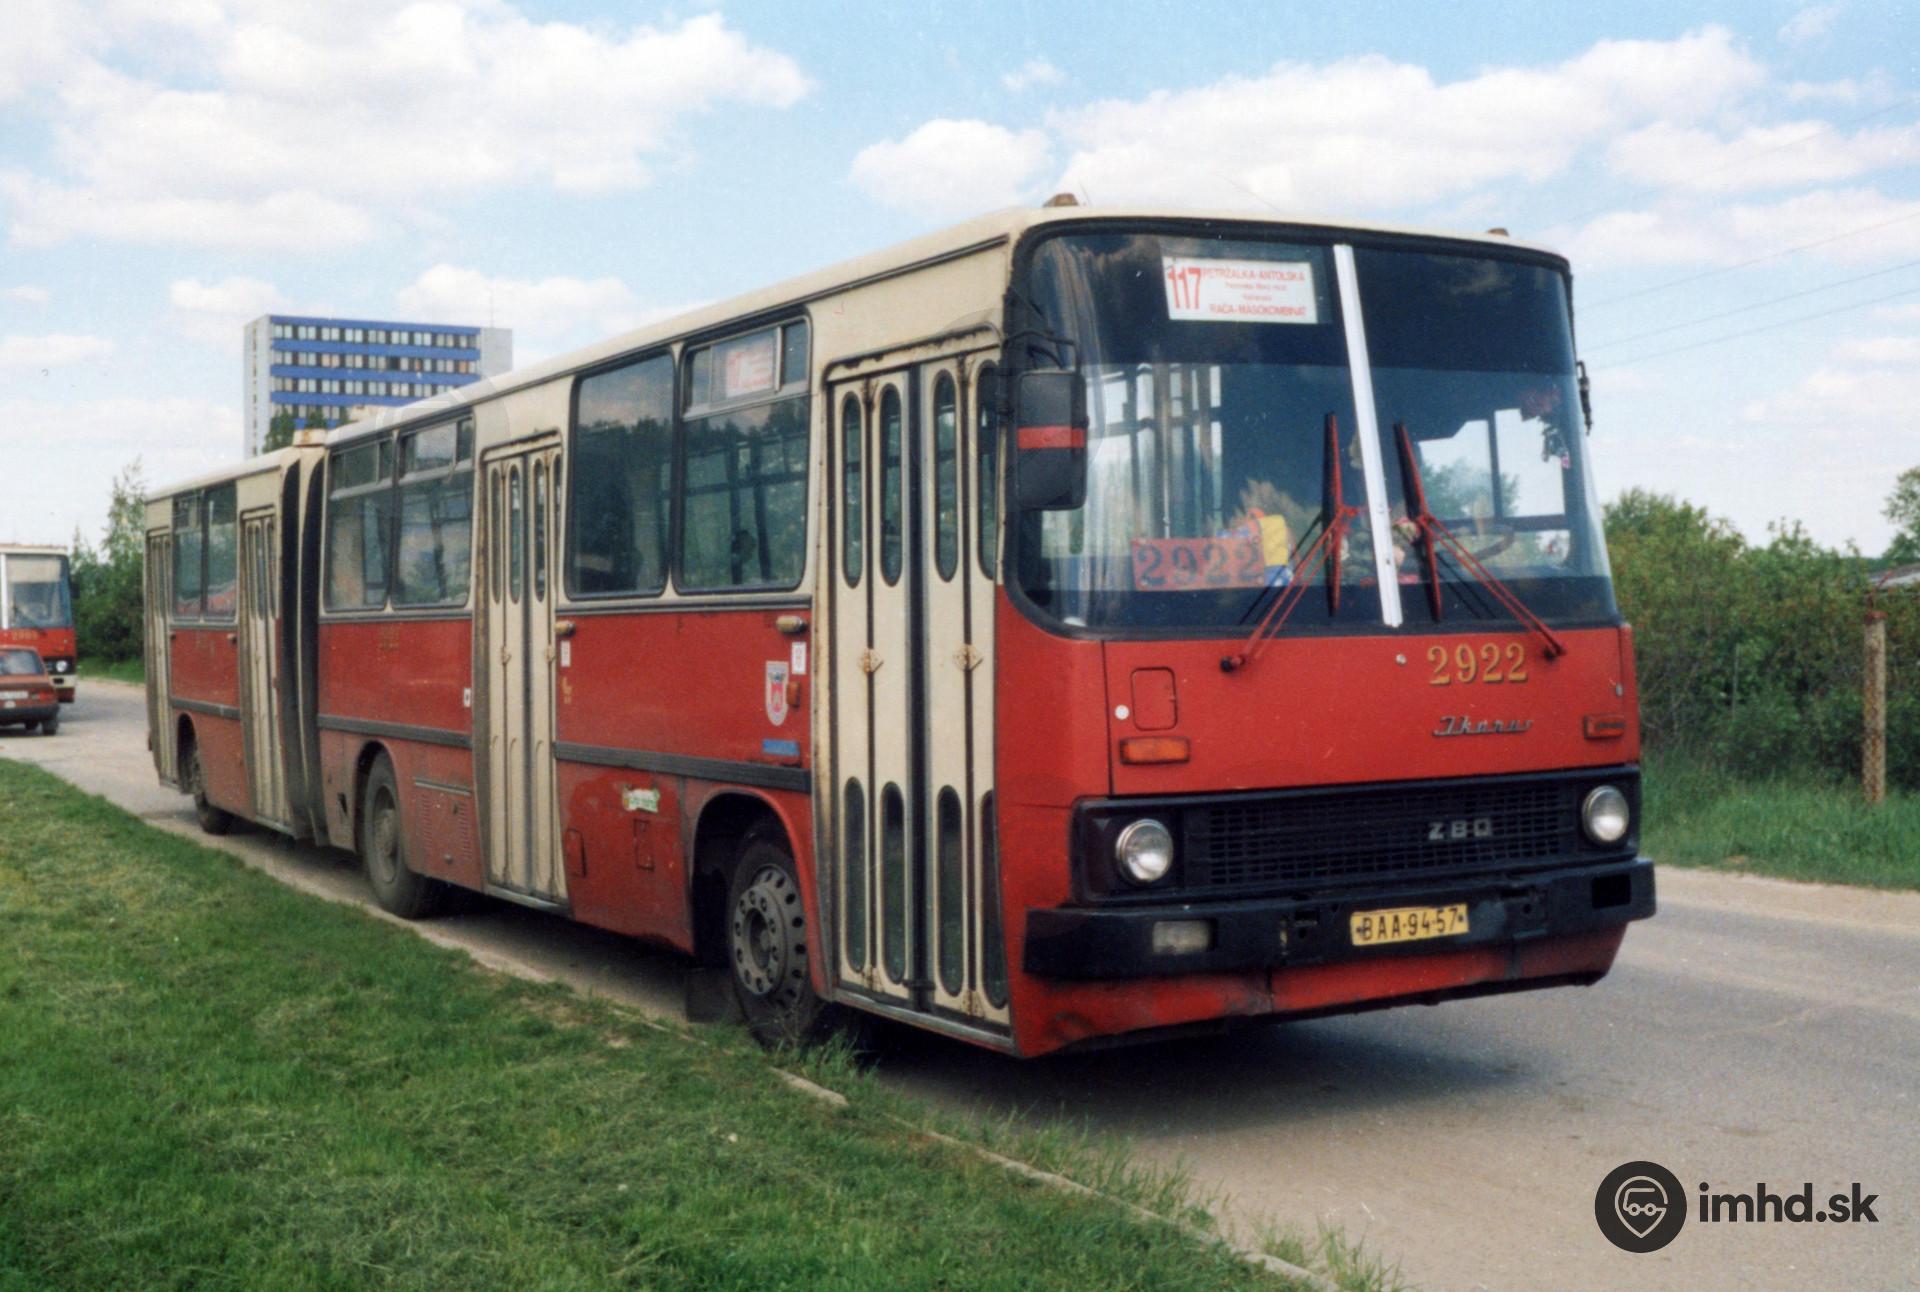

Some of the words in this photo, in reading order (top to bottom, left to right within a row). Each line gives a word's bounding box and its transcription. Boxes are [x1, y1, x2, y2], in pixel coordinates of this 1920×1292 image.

[1168, 264, 1201, 309] 117
[1137, 542, 1260, 586] 2922
[1427, 642, 1528, 685] 2922
[1433, 715, 1533, 736] Ikarus
